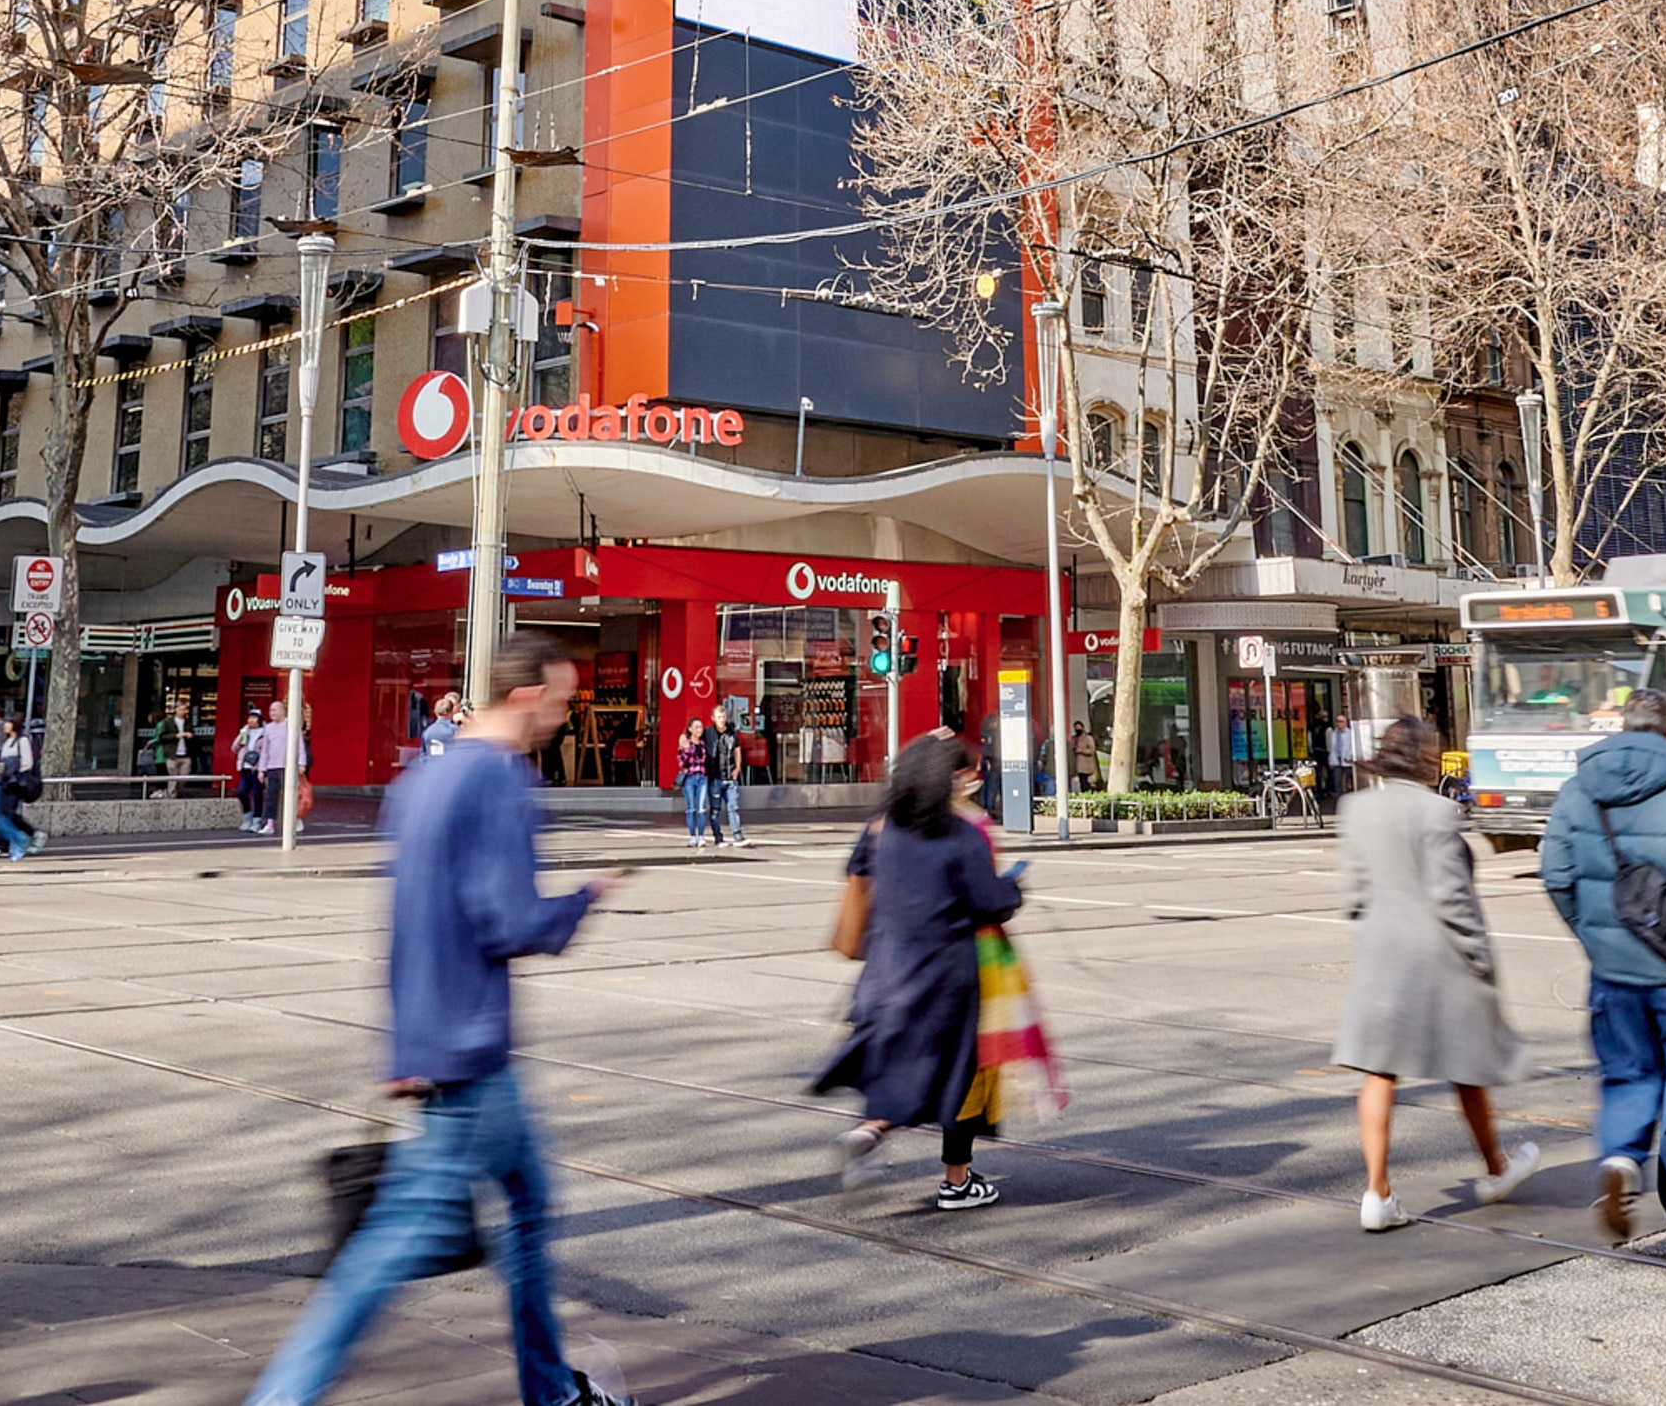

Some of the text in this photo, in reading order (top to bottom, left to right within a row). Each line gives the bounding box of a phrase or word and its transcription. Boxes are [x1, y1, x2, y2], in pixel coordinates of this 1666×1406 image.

[1498, 87, 1519, 105] 201
[527, 578, 554, 592] Swanston
[817, 572, 889, 594] vodafone
[286, 598, 320, 610] ONLY
[279, 624, 320, 634] GIVE WAY
[292, 637, 304, 647] TO
